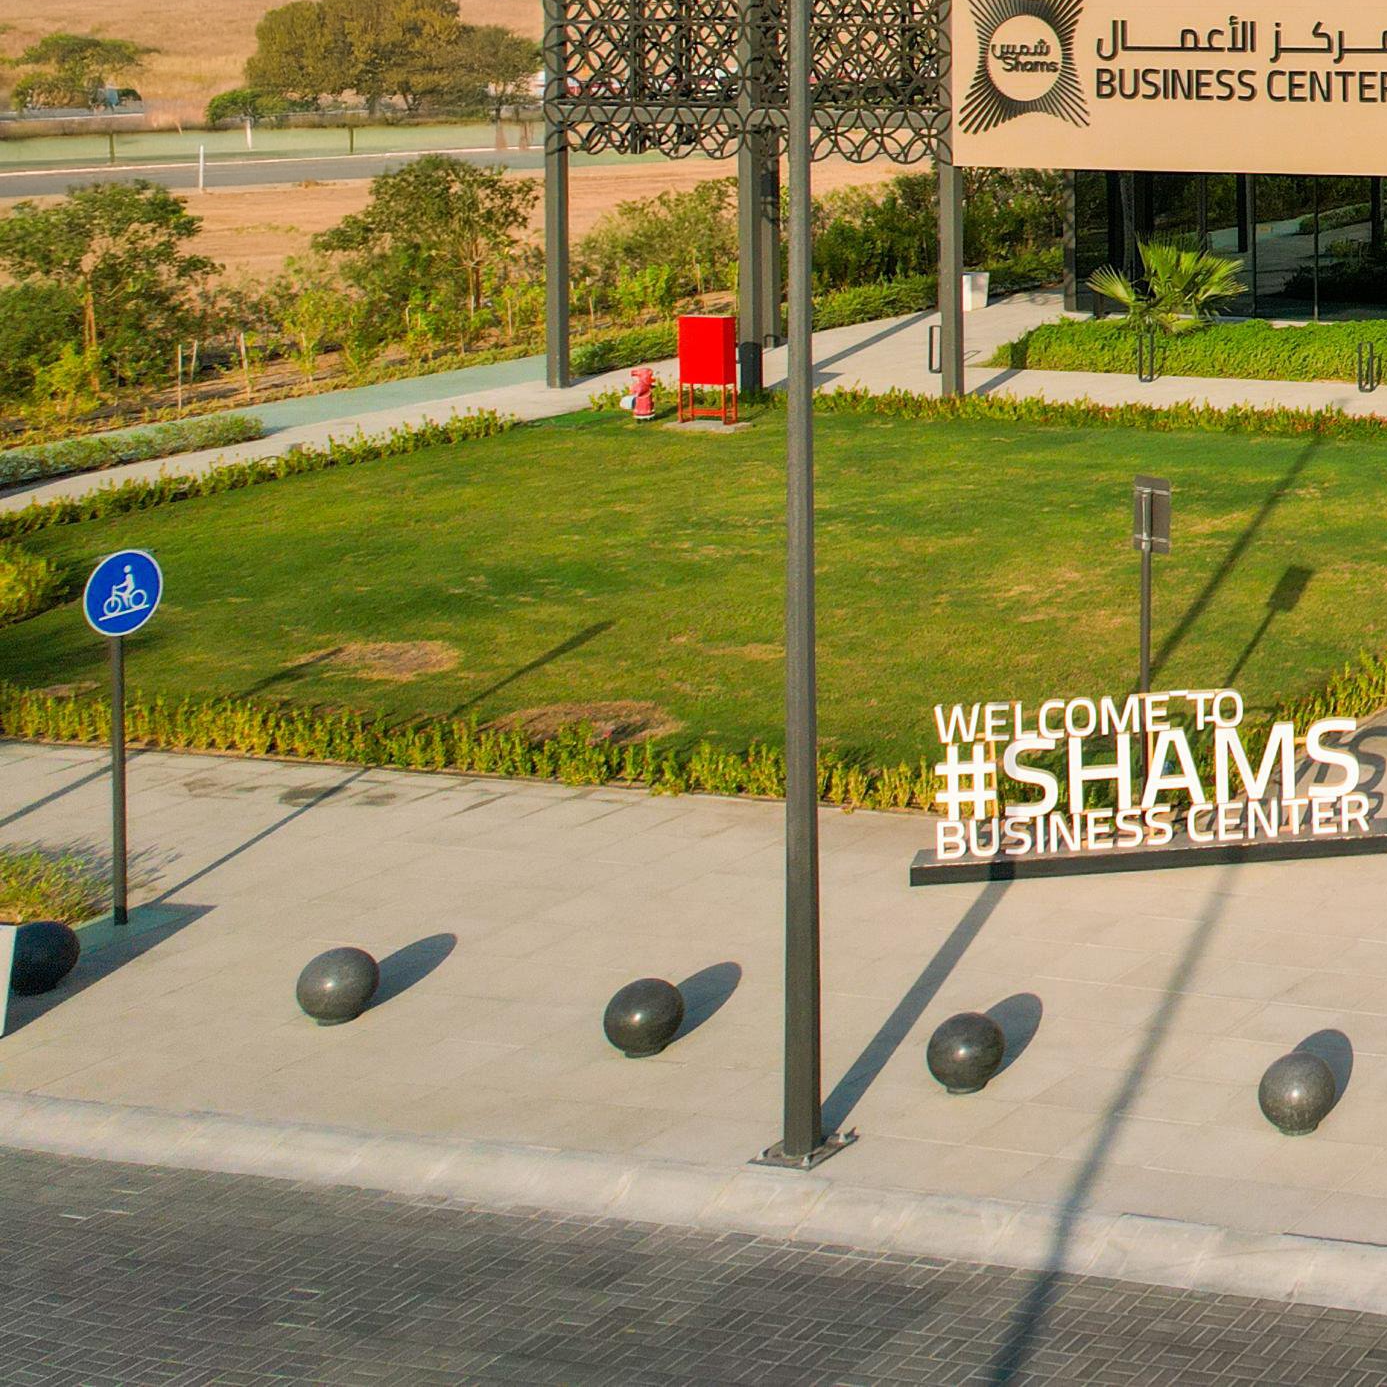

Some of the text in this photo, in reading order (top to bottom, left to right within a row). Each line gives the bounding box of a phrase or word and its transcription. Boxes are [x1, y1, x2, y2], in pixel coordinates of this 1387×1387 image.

[991, 38, 1051, 60] شمس
[1096, 15, 1257, 62] الأعمال
[1002, 54, 1059, 72] Shams
[1096, 68, 1257, 102] BUSINESS
[934, 688, 1244, 744] WELCOME TO
[934, 717, 1361, 821] #SHAMS
[936, 793, 1371, 860] BUSINESS CENTER
